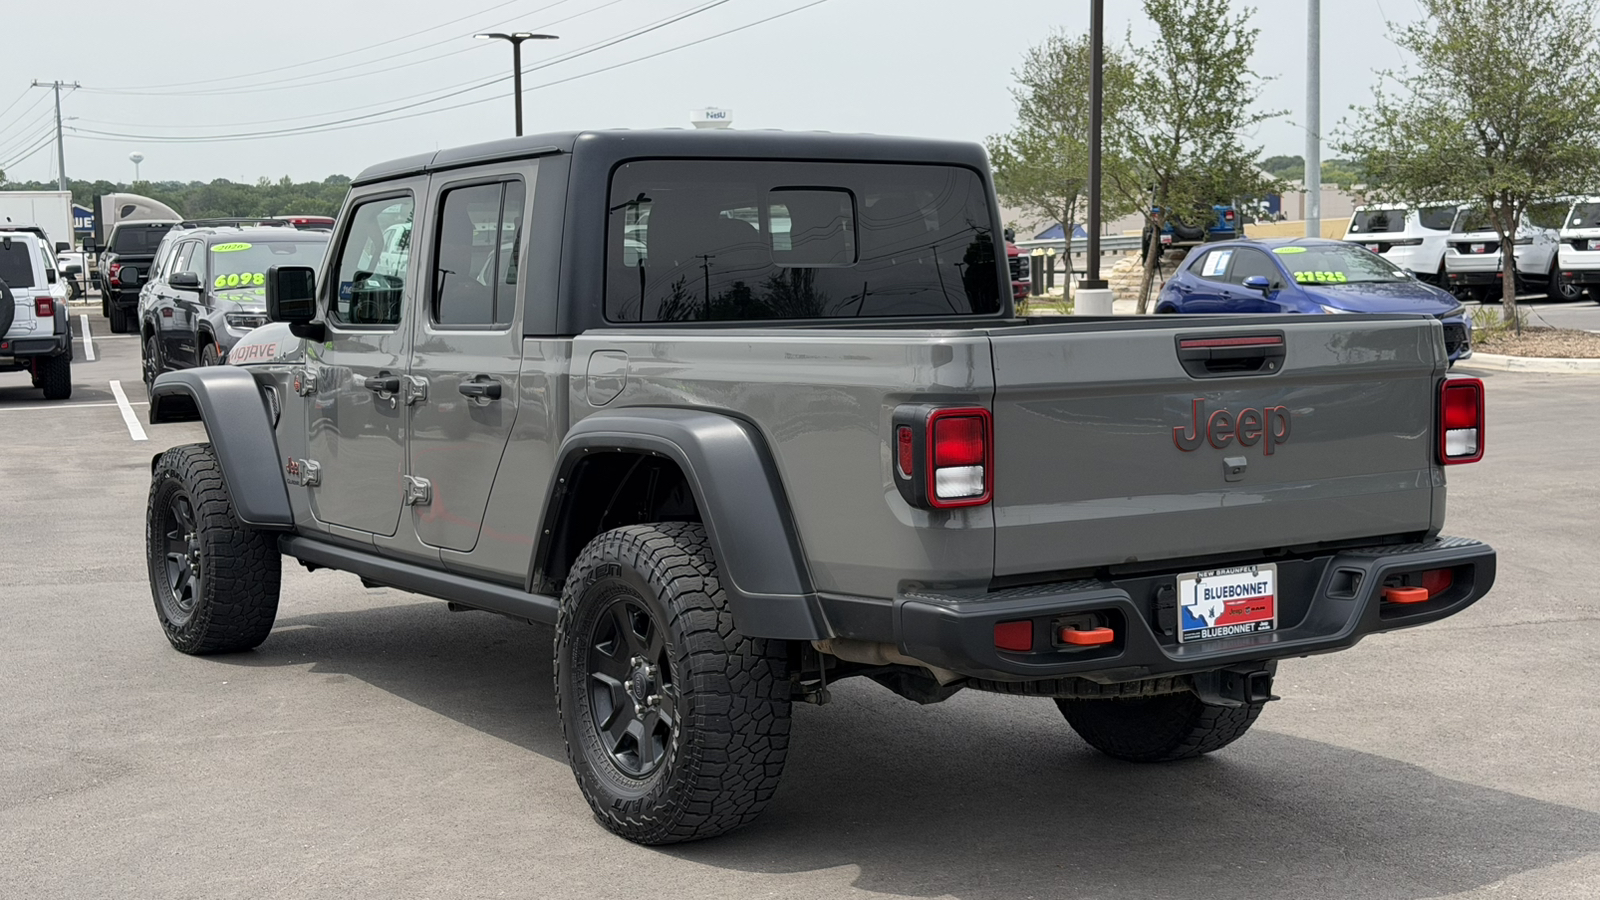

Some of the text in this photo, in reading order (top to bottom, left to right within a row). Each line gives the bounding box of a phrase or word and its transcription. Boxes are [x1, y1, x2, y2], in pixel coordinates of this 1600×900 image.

[230, 342, 277, 362] MOJAVE
[1172, 397, 1291, 456] Jeep
[1198, 566, 1257, 578] NEW BRAUNFELS
[1204, 581, 1268, 600] BLUEBONNET
[1202, 623, 1256, 638] BLUEBONNET
